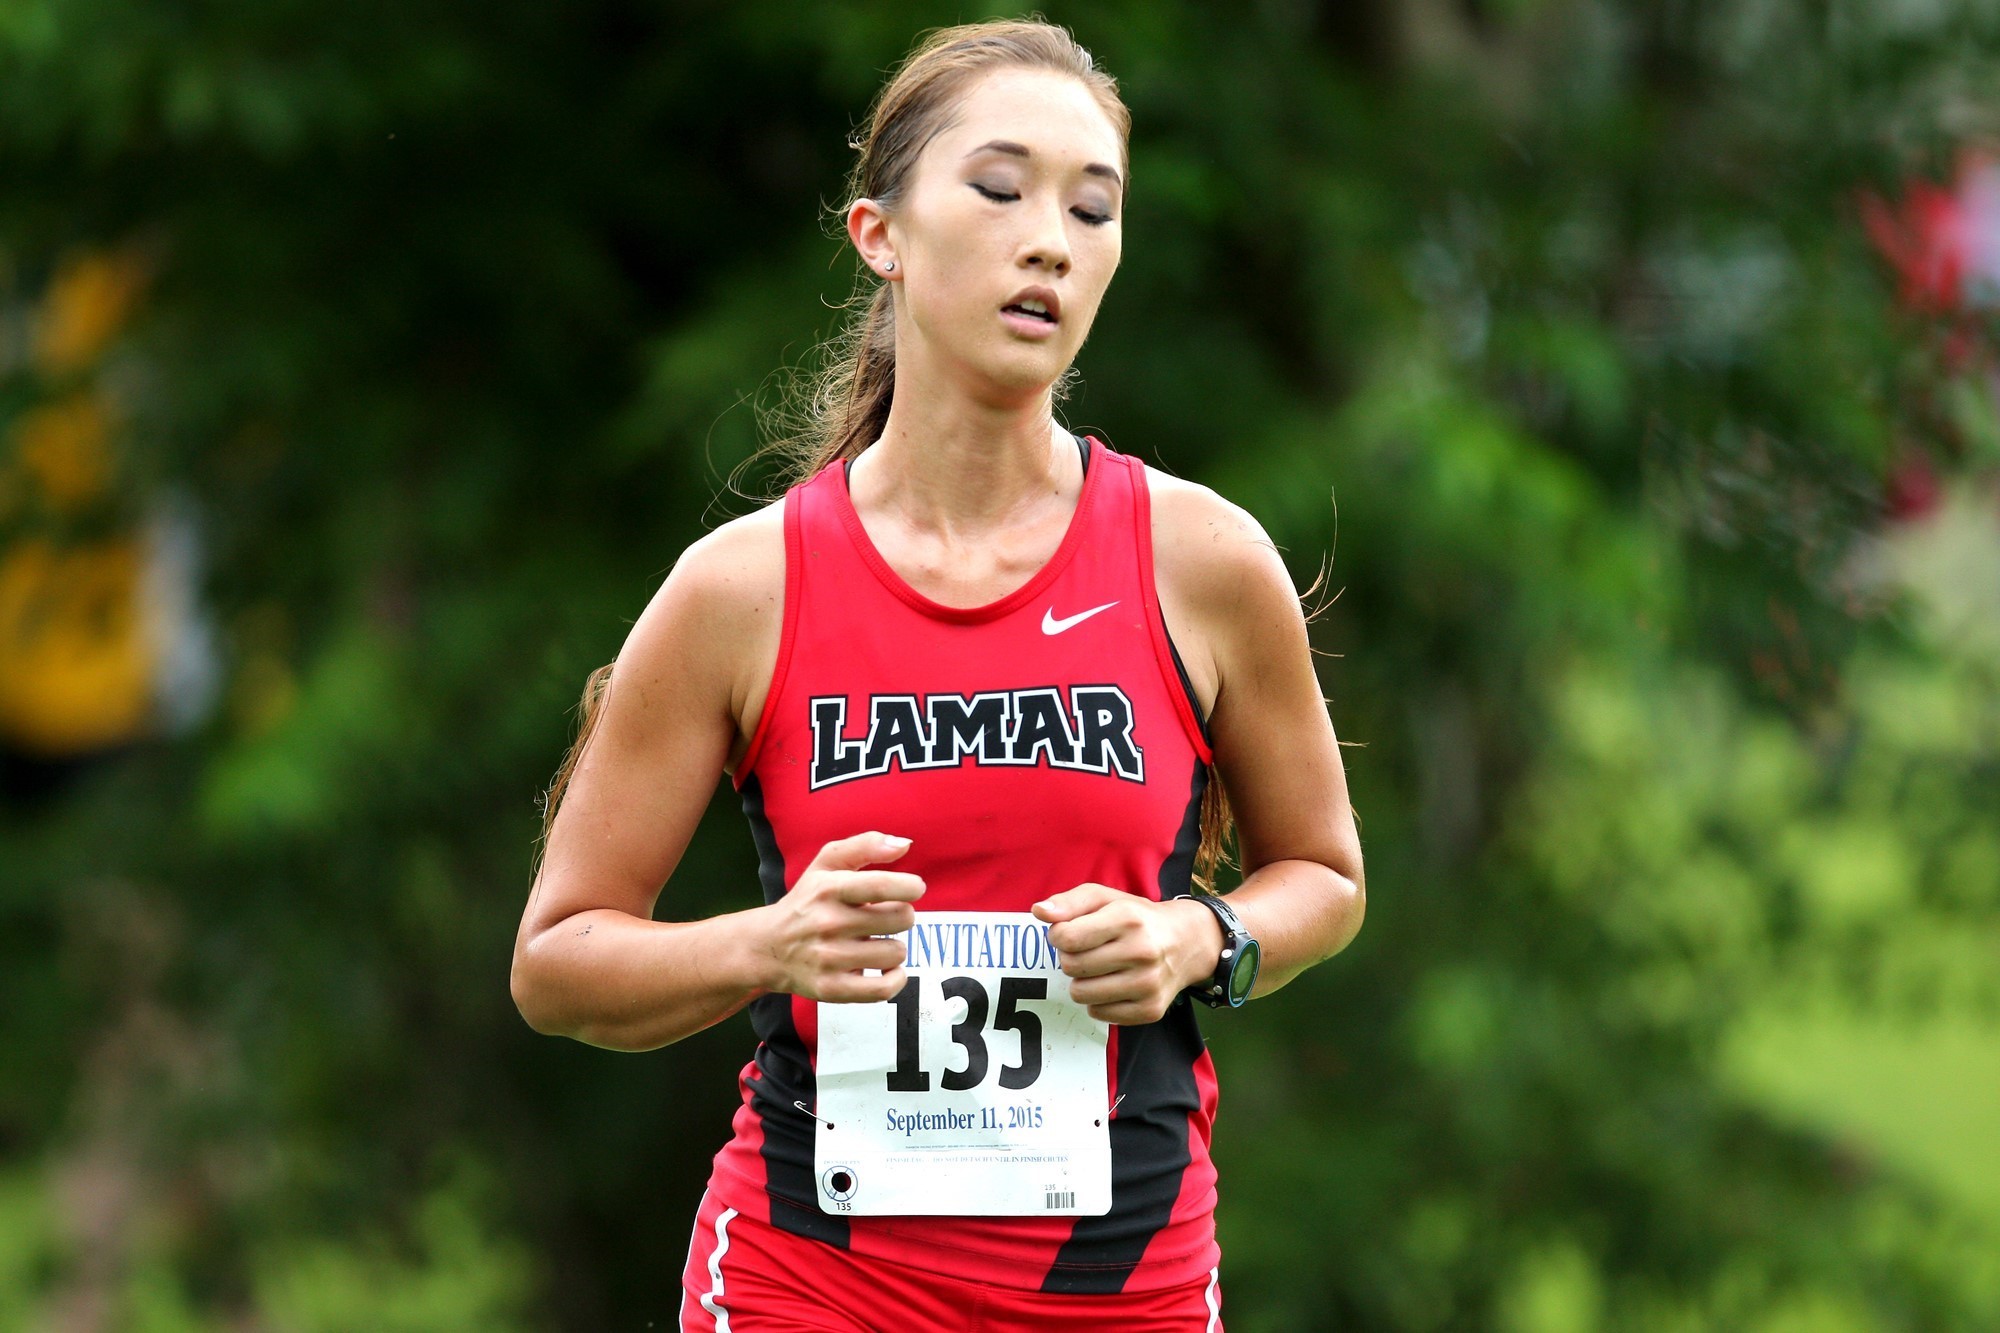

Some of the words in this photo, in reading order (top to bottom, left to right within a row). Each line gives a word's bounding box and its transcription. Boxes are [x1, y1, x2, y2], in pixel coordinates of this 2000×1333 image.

[809, 684, 1146, 793] LAMAR
[905, 923, 1063, 970] INVITATION
[886, 976, 1048, 1092] 135
[886, 1107, 976, 1137] September
[980, 1107, 1003, 1134] 11,
[1008, 1106, 1043, 1129] 2015
[836, 1202, 852, 1211] 135
